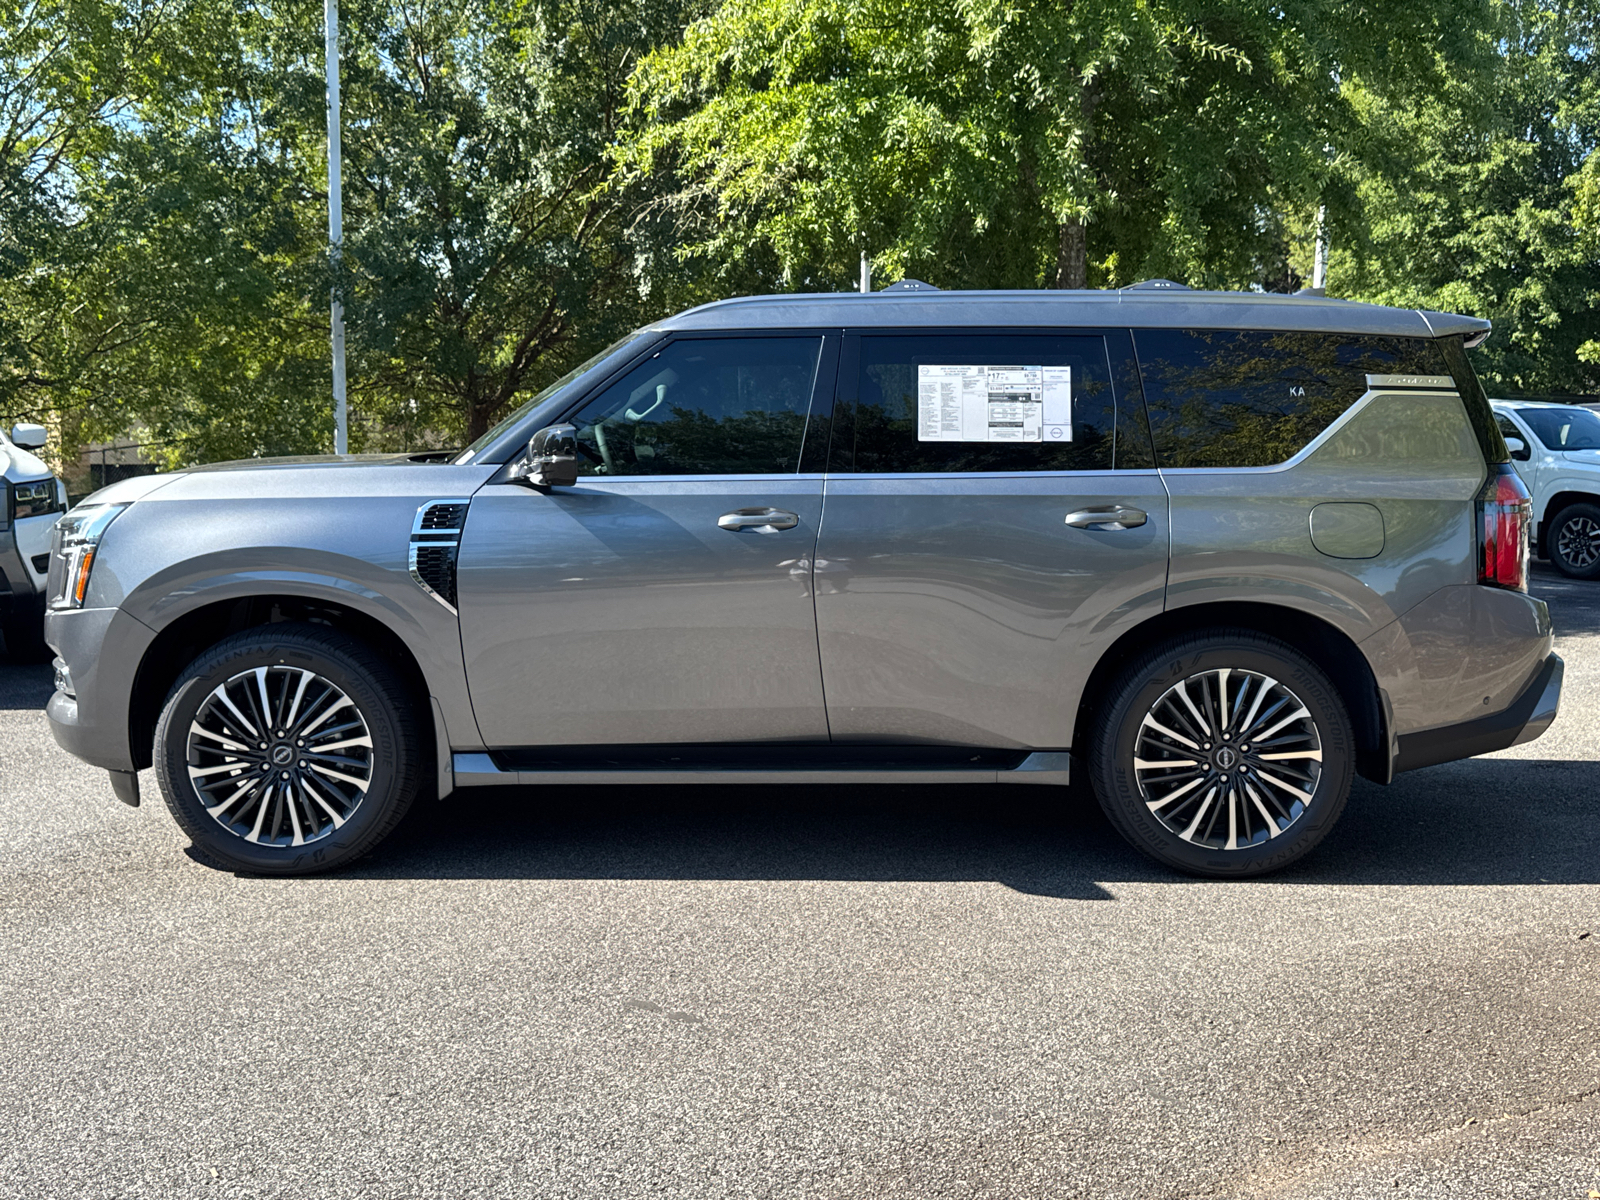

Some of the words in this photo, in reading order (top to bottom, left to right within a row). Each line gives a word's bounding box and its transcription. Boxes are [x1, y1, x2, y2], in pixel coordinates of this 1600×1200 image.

[1289, 386, 1305, 397] KA
[208, 646, 266, 672] ALENZA
[346, 677, 393, 767] BRIDGESTONE
[1289, 668, 1345, 754] BRIDGESTONE
[1113, 766, 1171, 851] BRIDGESTONE
[1255, 836, 1311, 868] ALENZA
